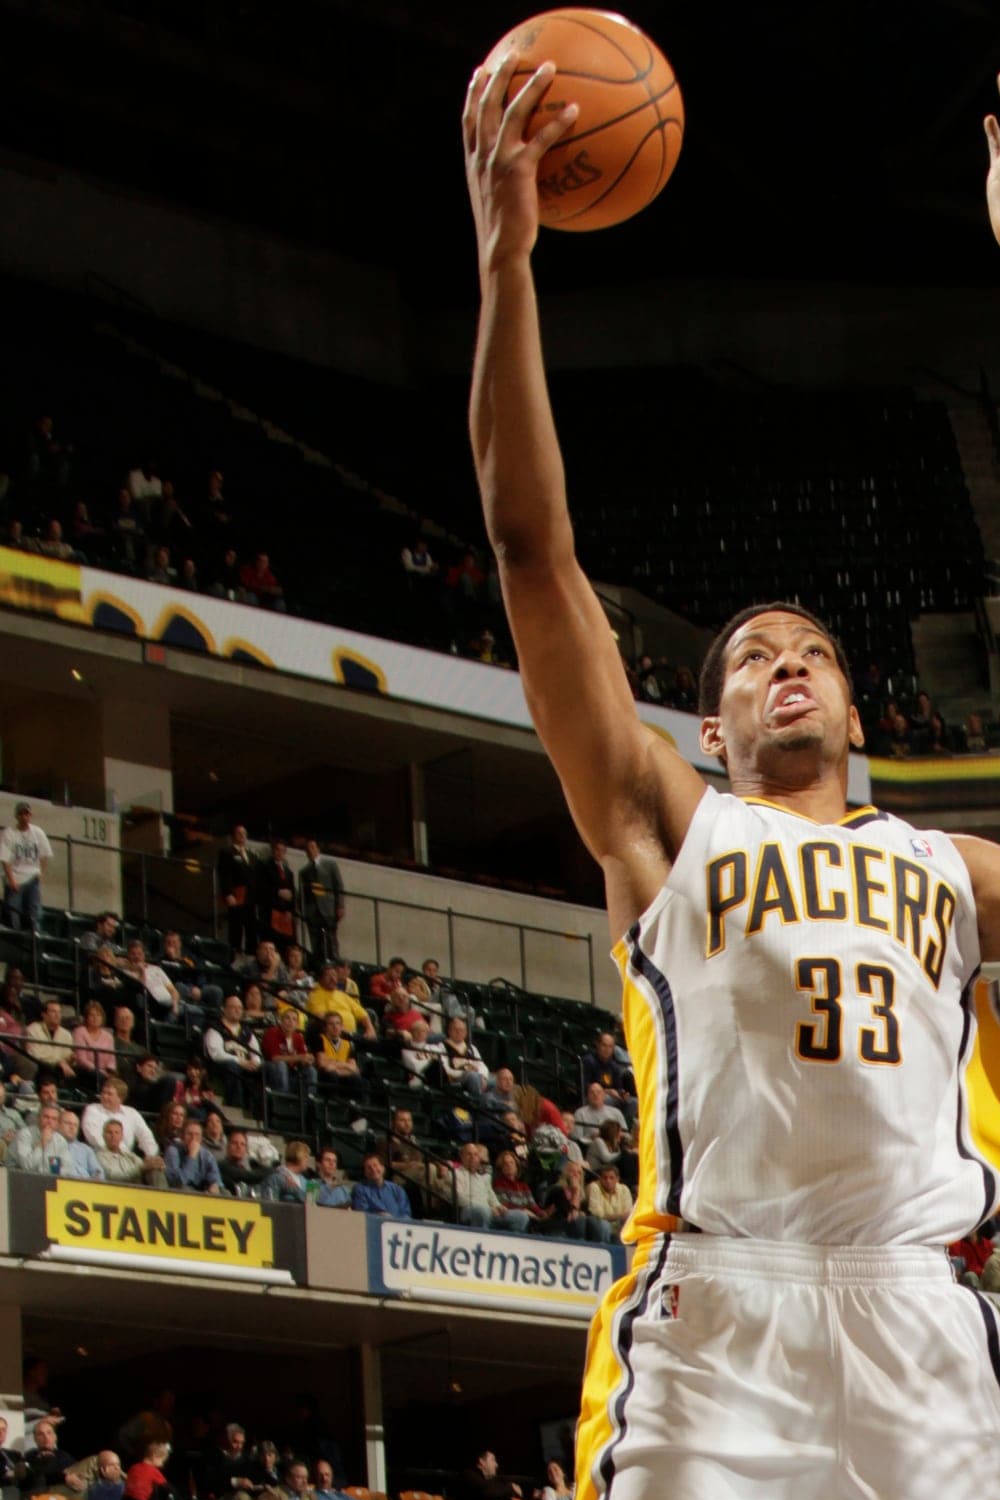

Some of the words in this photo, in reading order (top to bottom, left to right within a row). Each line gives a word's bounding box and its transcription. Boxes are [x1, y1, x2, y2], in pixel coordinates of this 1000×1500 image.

[704, 840, 958, 993] PACERS
[794, 956, 904, 1068] 33
[63, 1199, 256, 1255] STANLEY
[387, 1229, 609, 1293] ticketmaster
